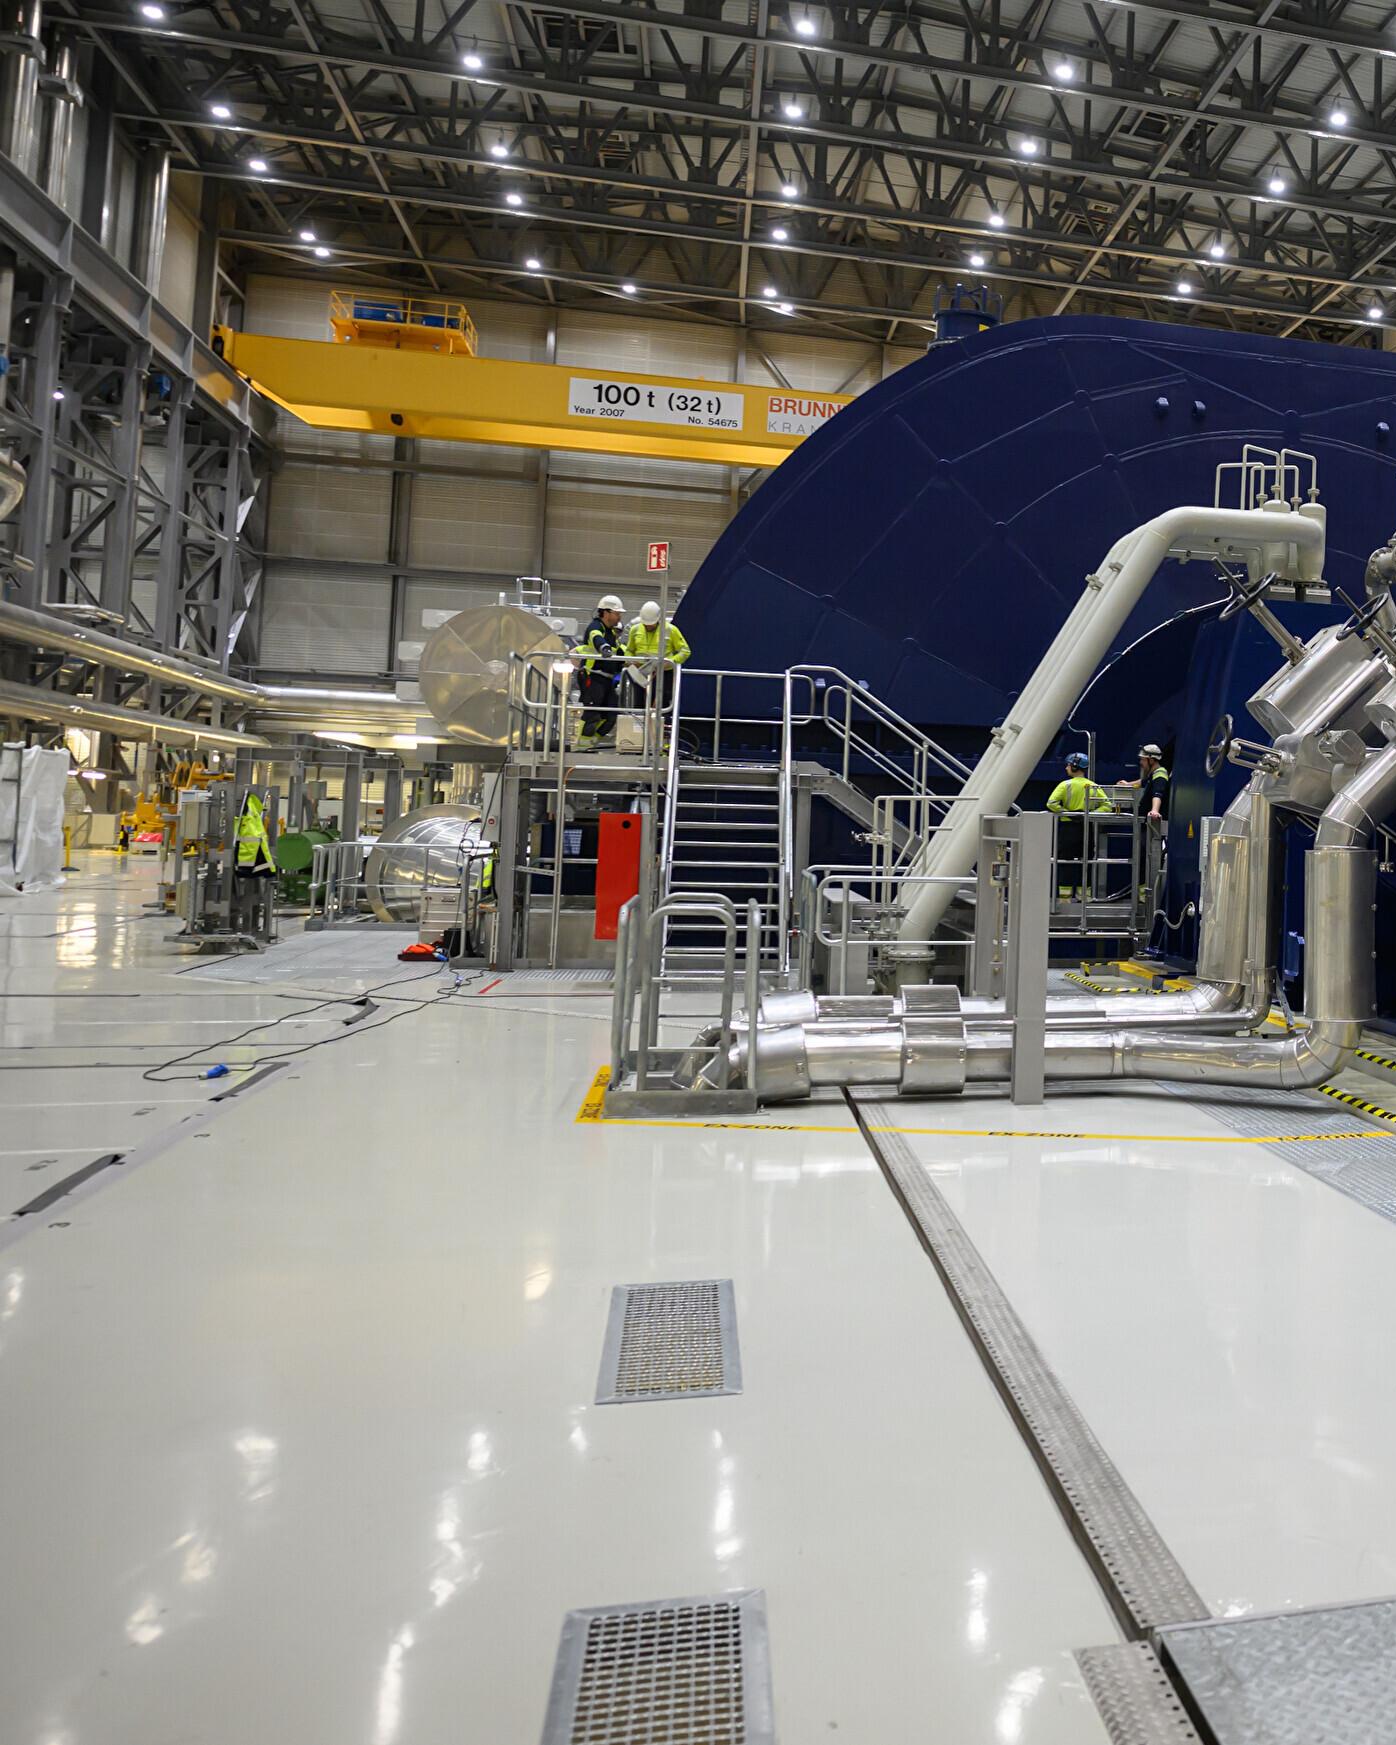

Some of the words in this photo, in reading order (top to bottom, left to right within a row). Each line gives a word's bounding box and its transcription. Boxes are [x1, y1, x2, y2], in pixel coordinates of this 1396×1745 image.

[593, 384, 640, 406] 100
[646, 391, 655, 408] t
[668, 392, 702, 412] (32
[706, 397, 721, 415] t)
[769, 397, 847, 418] BRUNN
[573, 405, 595, 414] Year
[599, 408, 625, 417] 2007
[688, 416, 704, 425] No.
[708, 418, 738, 428] 54675
